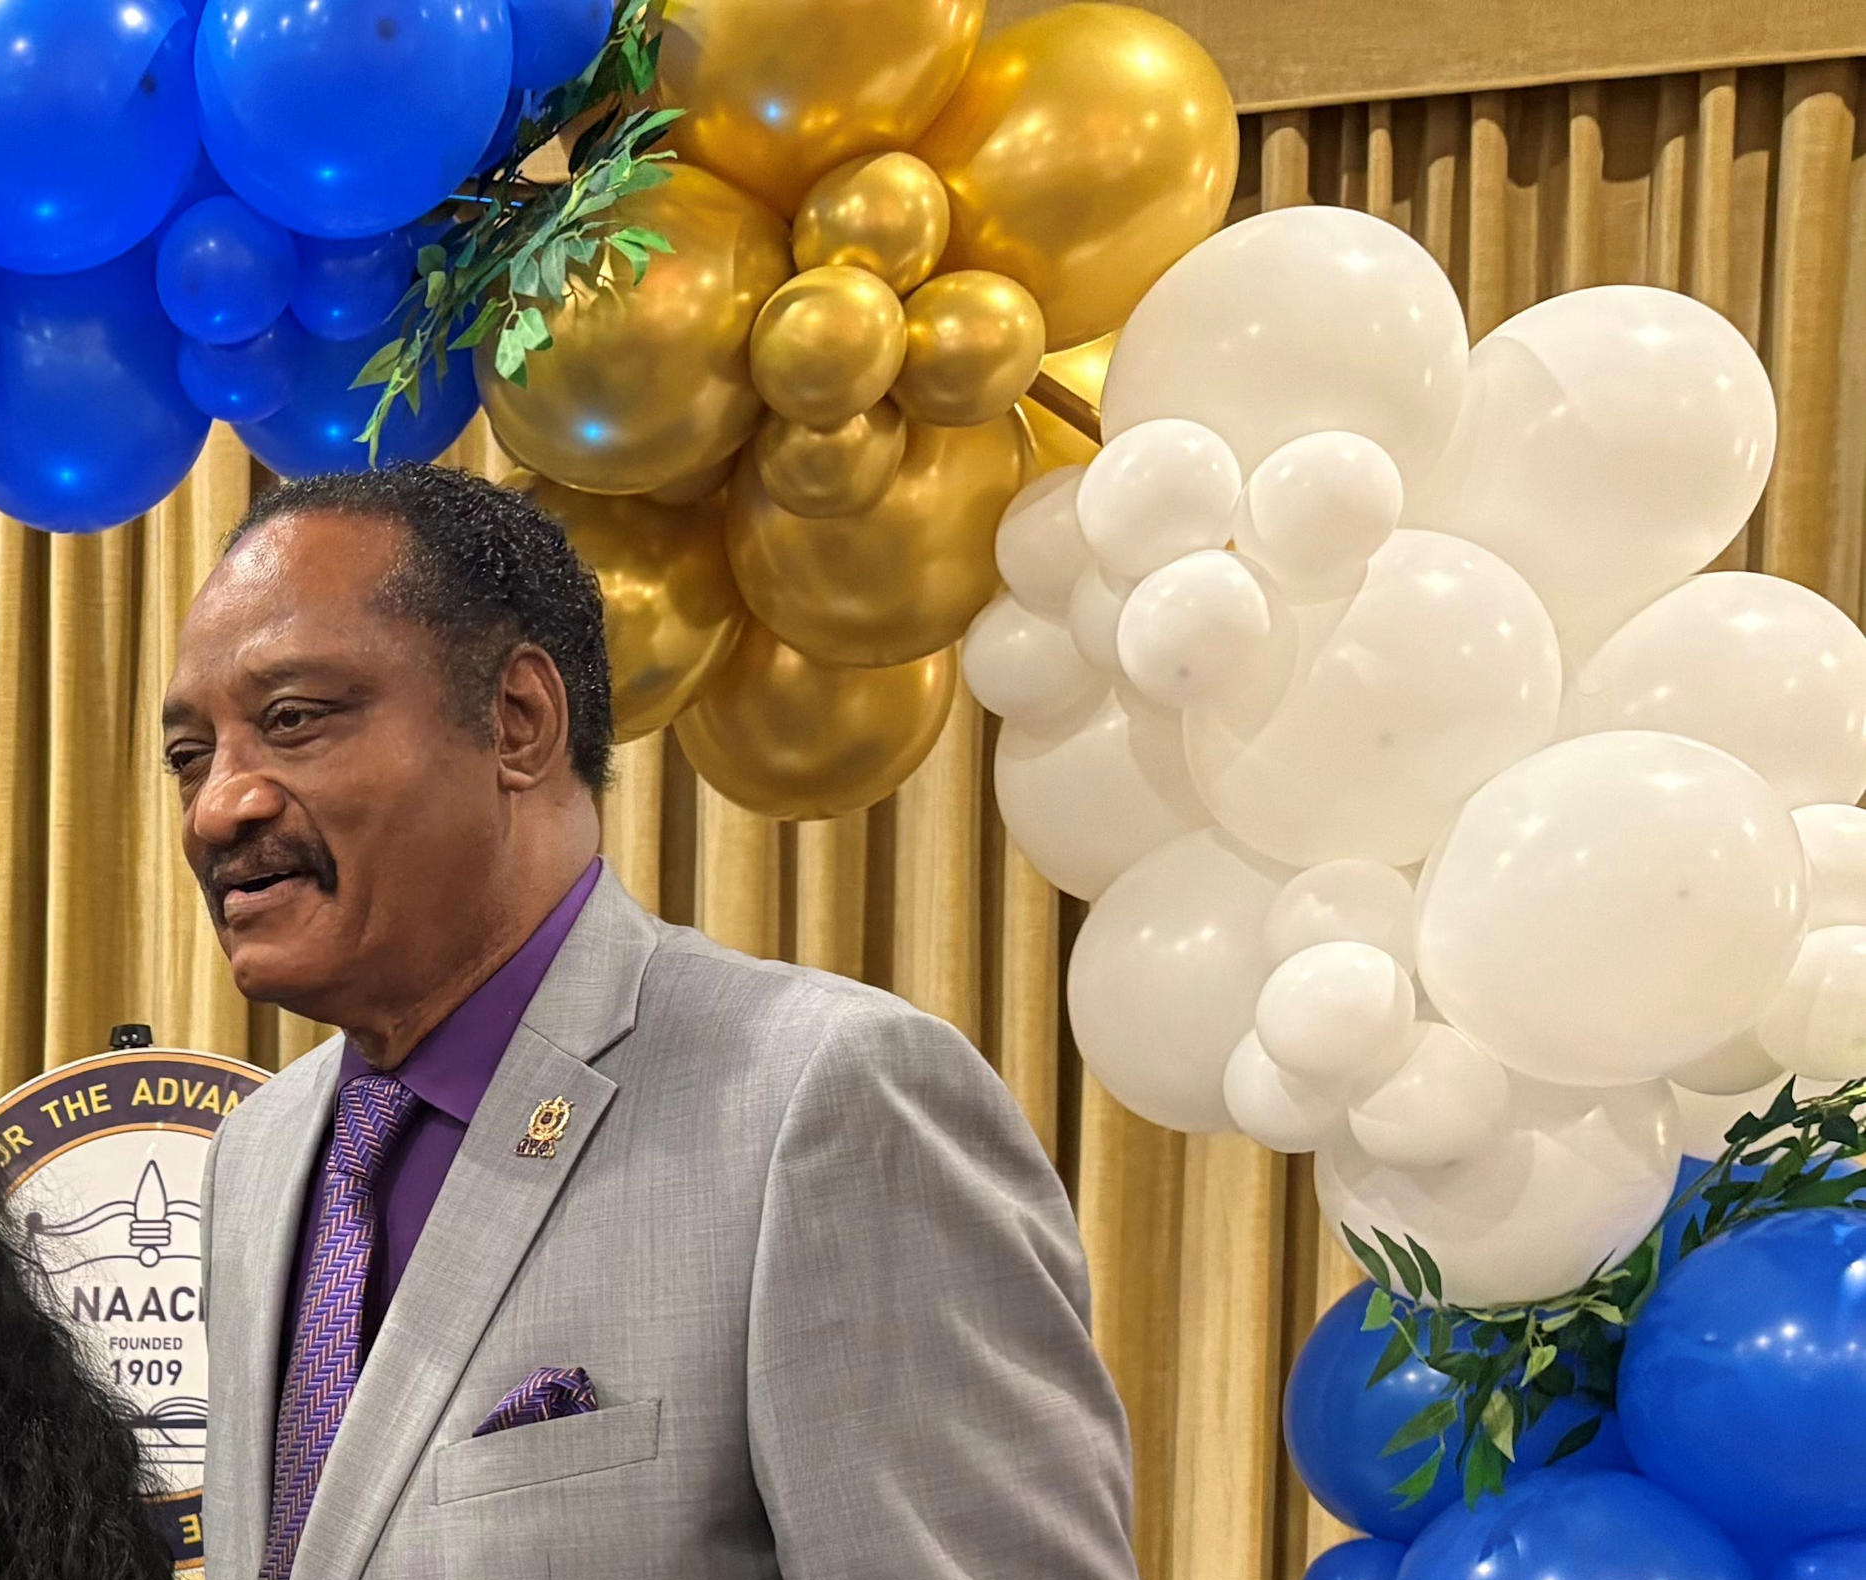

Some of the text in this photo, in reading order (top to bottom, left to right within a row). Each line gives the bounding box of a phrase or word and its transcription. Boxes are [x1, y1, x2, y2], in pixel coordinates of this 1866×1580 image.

[40, 1083, 112, 1129] THE
[110, 1337, 183, 1350] FOUNDED
[110, 1359, 183, 1386] 1909
